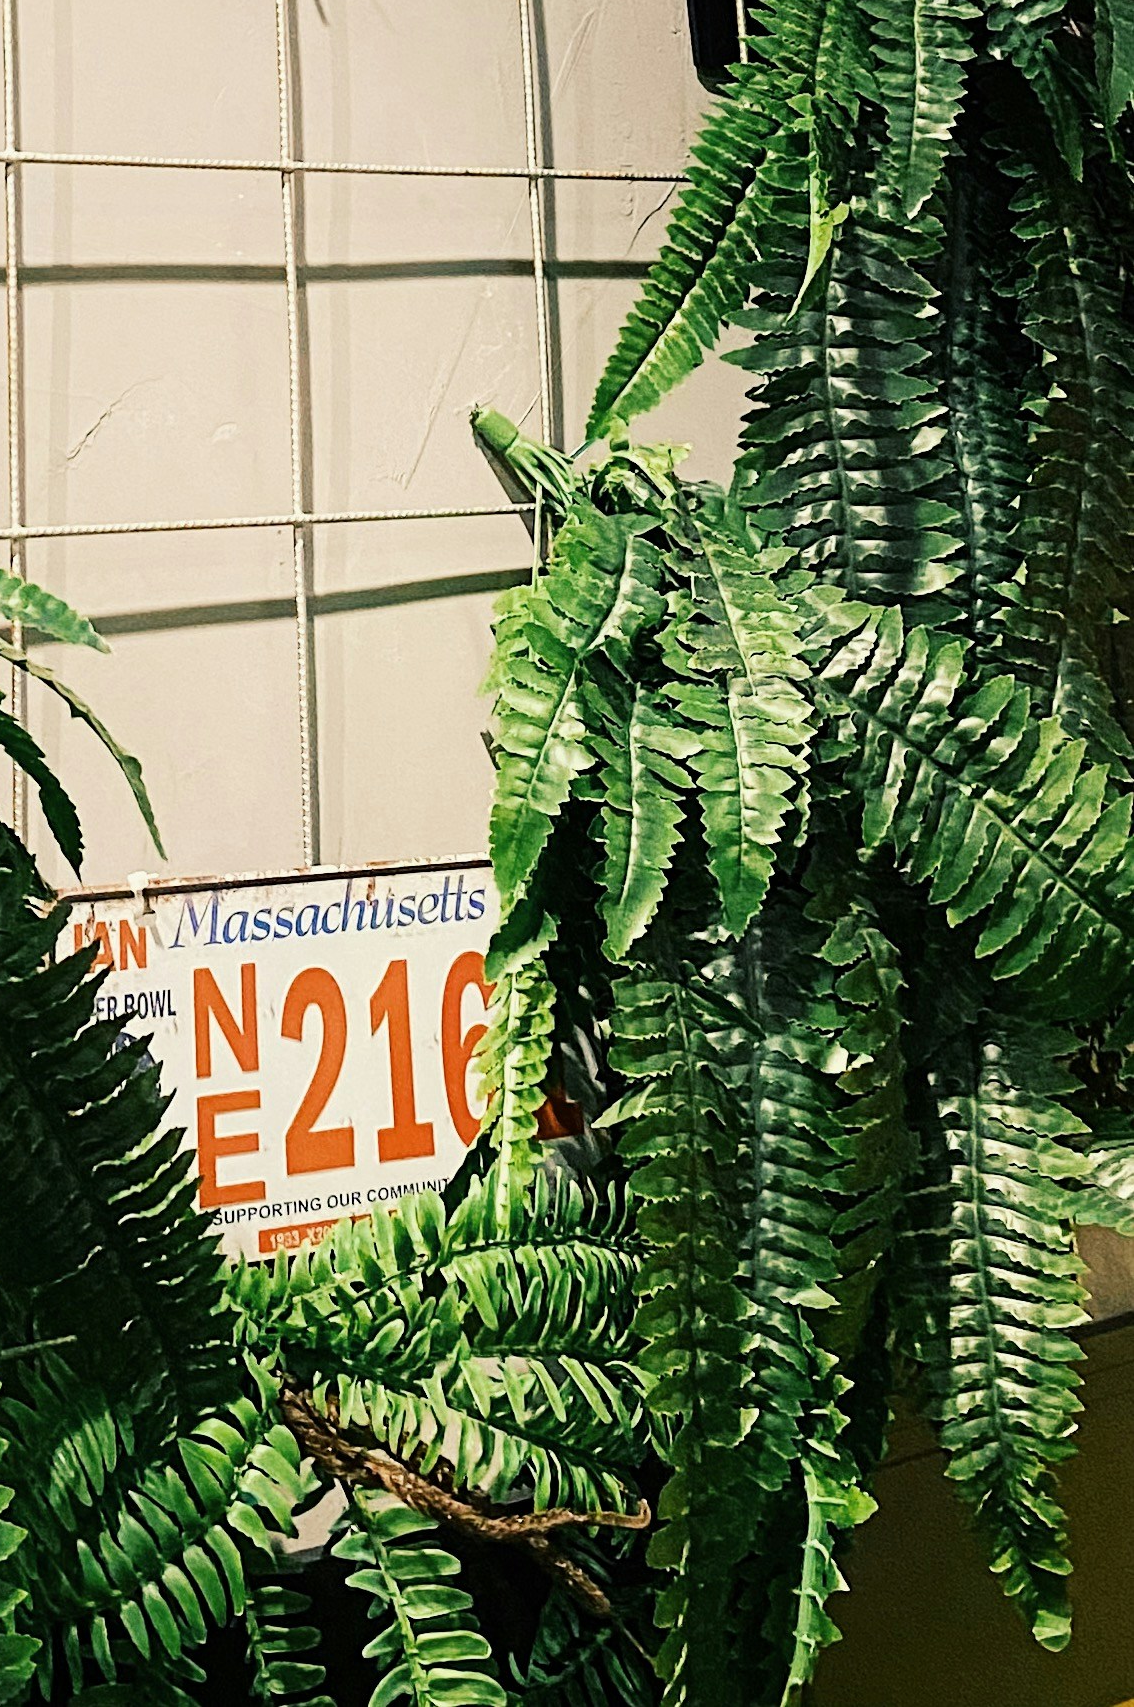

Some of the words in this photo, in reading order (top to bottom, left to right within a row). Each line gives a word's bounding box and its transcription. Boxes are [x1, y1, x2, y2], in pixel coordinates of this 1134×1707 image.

[169, 876, 487, 949] Massachusetts
[125, 989, 177, 1020] BOWL
[281, 950, 546, 1177] 216
[213, 1197, 322, 1226] SUPPORTING
[327, 1191, 362, 1209] OUR
